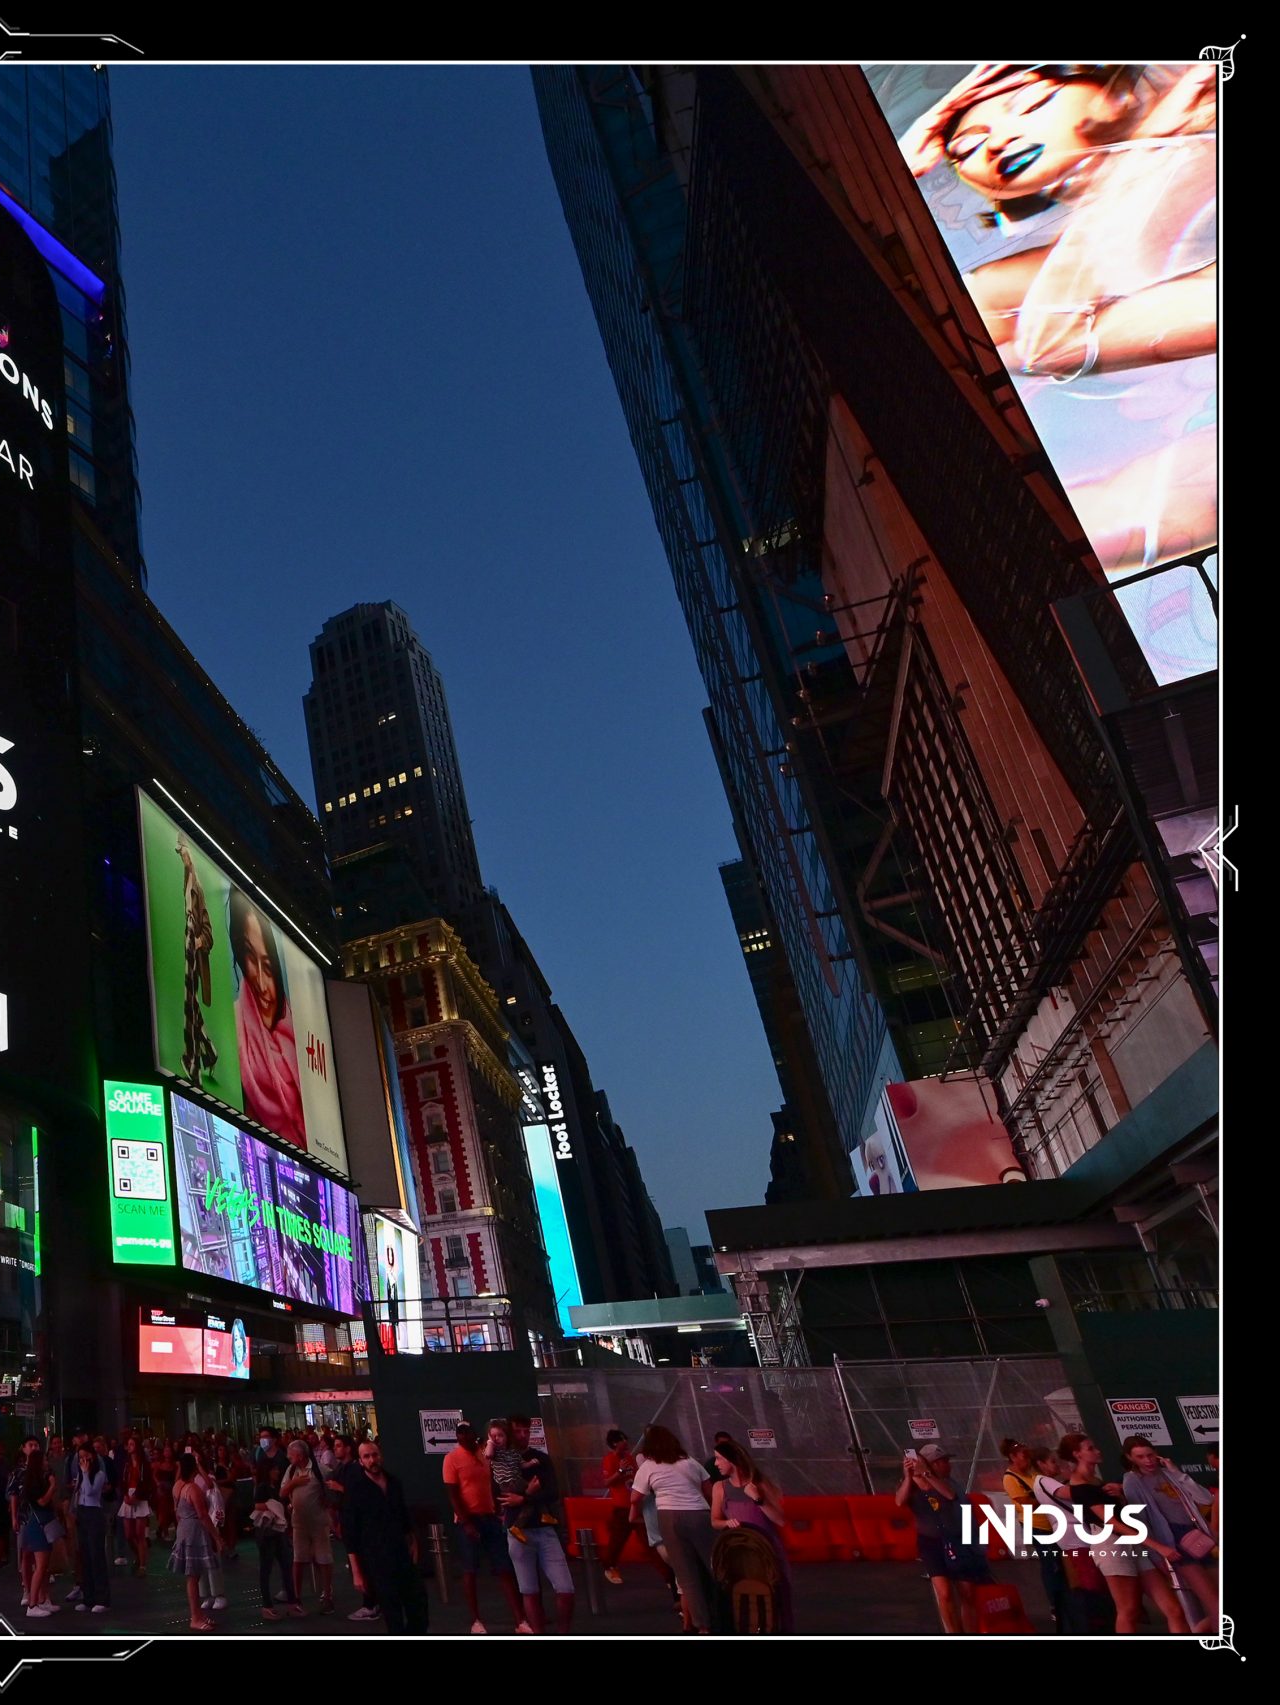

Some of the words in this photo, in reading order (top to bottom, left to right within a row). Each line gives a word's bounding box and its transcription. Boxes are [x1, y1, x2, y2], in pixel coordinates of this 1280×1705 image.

[306, 1031, 327, 1083] H&M
[113, 1089, 153, 1103] GAME
[108, 1099, 163, 1117] SQUARE
[551, 1122, 573, 1160] Foot
[117, 1203, 146, 1215] SCAN
[149, 1205, 166, 1216] ME
[204, 1170, 261, 1227] VEGAS
[261, 1199, 277, 1231] IN
[276, 1205, 313, 1246] TIMES
[312, 1216, 354, 1262] SQUARE
[1117, 1403, 1151, 1411] DANGER
[1181, 1463, 1203, 1473] POST
